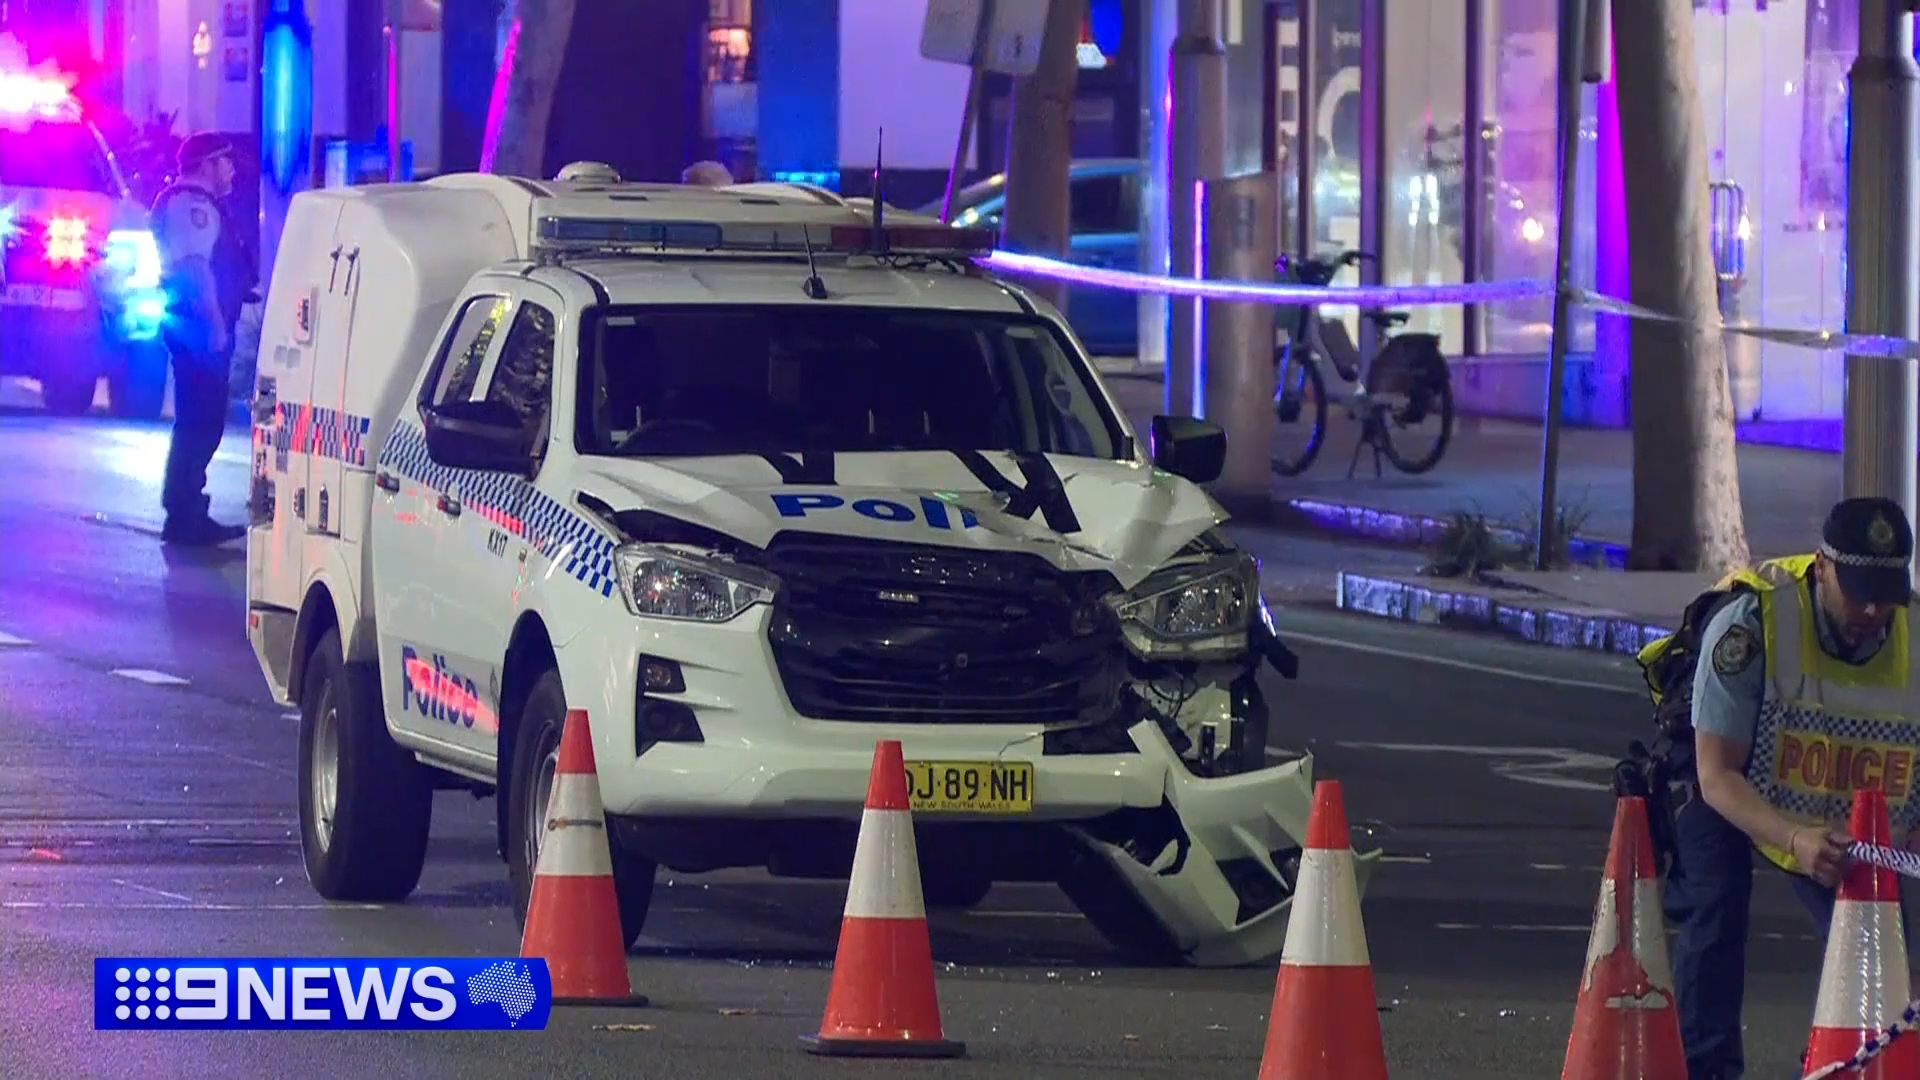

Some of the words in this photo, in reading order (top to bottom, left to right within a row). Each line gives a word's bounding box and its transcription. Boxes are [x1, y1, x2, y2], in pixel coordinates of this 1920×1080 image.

[402, 645, 478, 729] Police
[1778, 734, 1910, 797] POLICE
[913, 801, 937, 809] NEW
[941, 801, 974, 809] SOUTH
[979, 801, 1011, 809] WALES
